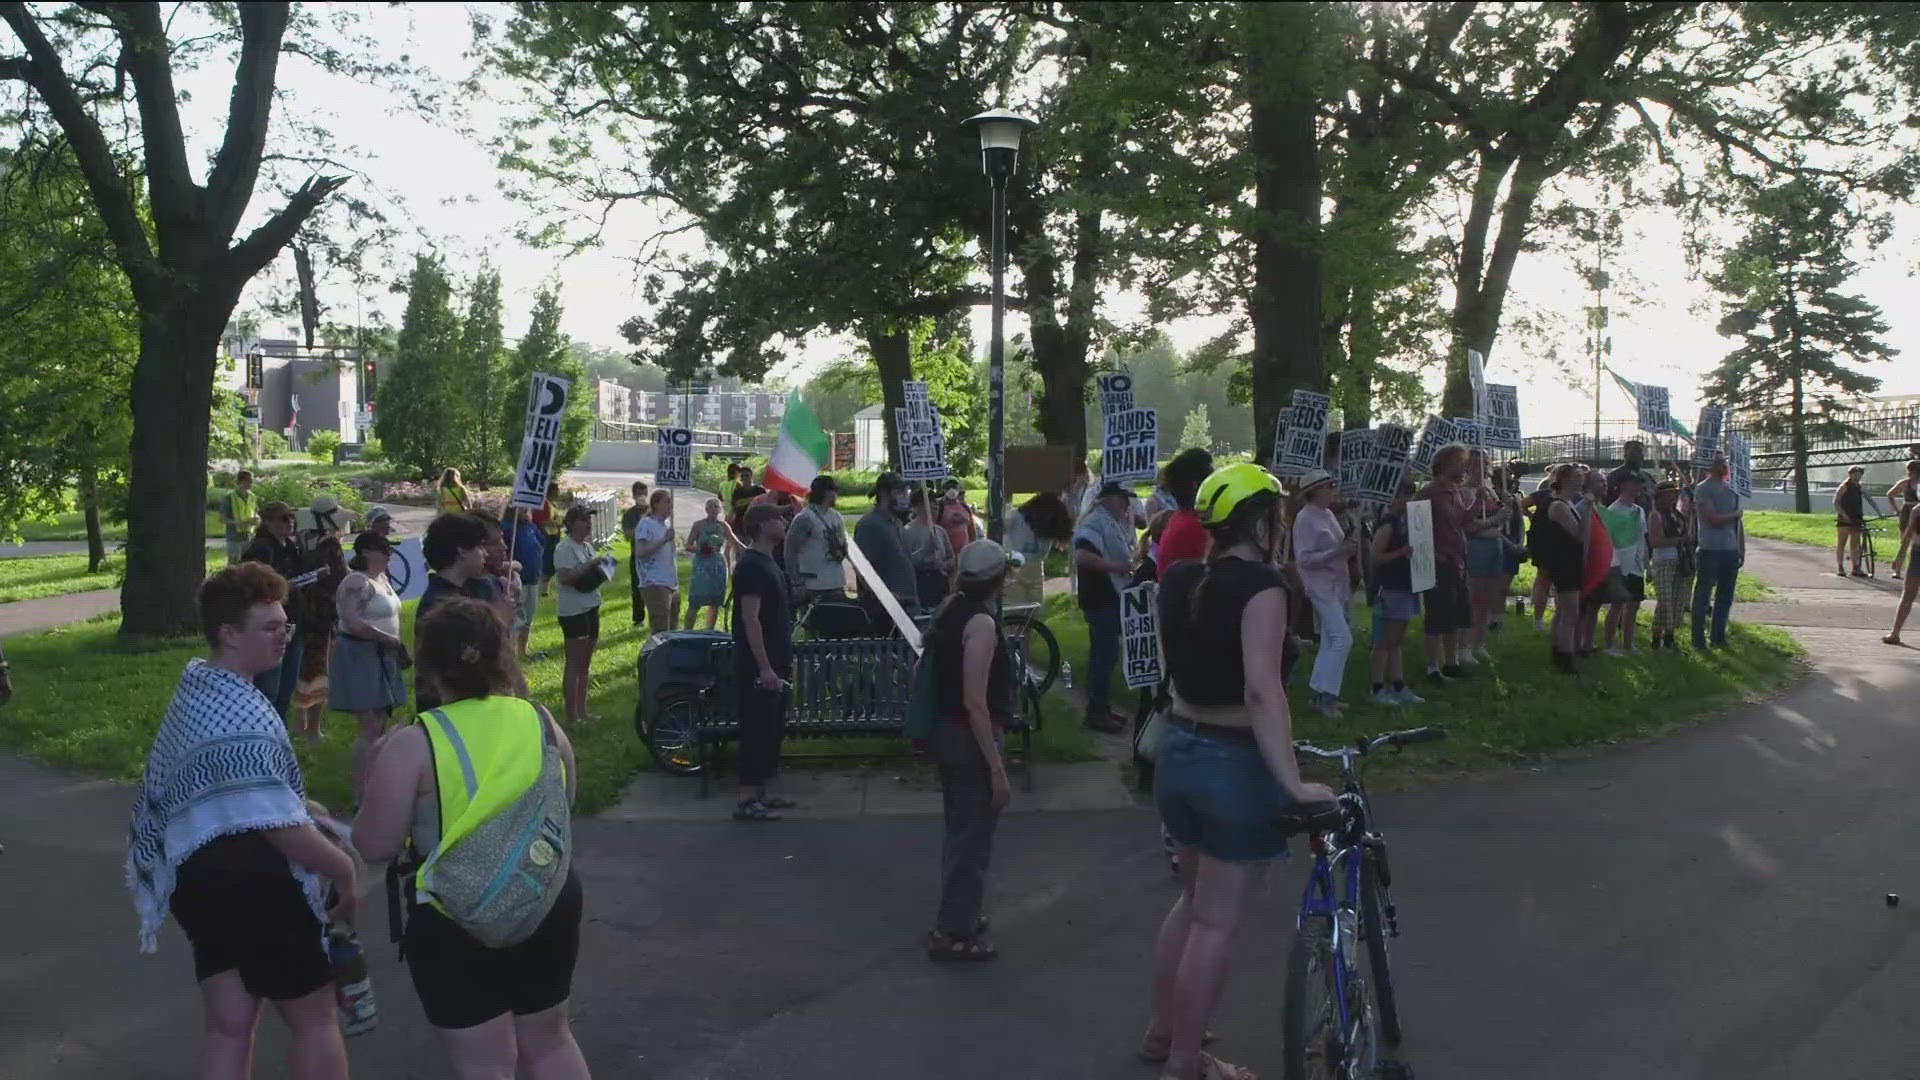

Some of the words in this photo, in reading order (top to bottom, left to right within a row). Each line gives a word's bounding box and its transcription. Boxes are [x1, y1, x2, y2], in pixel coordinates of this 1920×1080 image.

[1097, 375, 1132, 393] NO
[1107, 410, 1156, 435] HANDS
[658, 429, 692, 446] NO
[911, 436, 932, 448] AST
[1107, 431, 1156, 448] OFF
[1485, 427, 1519, 440] EAST
[1105, 446, 1155, 475] IRAN!
[1124, 589, 1149, 619] N
[1128, 659, 1160, 676] IRA
